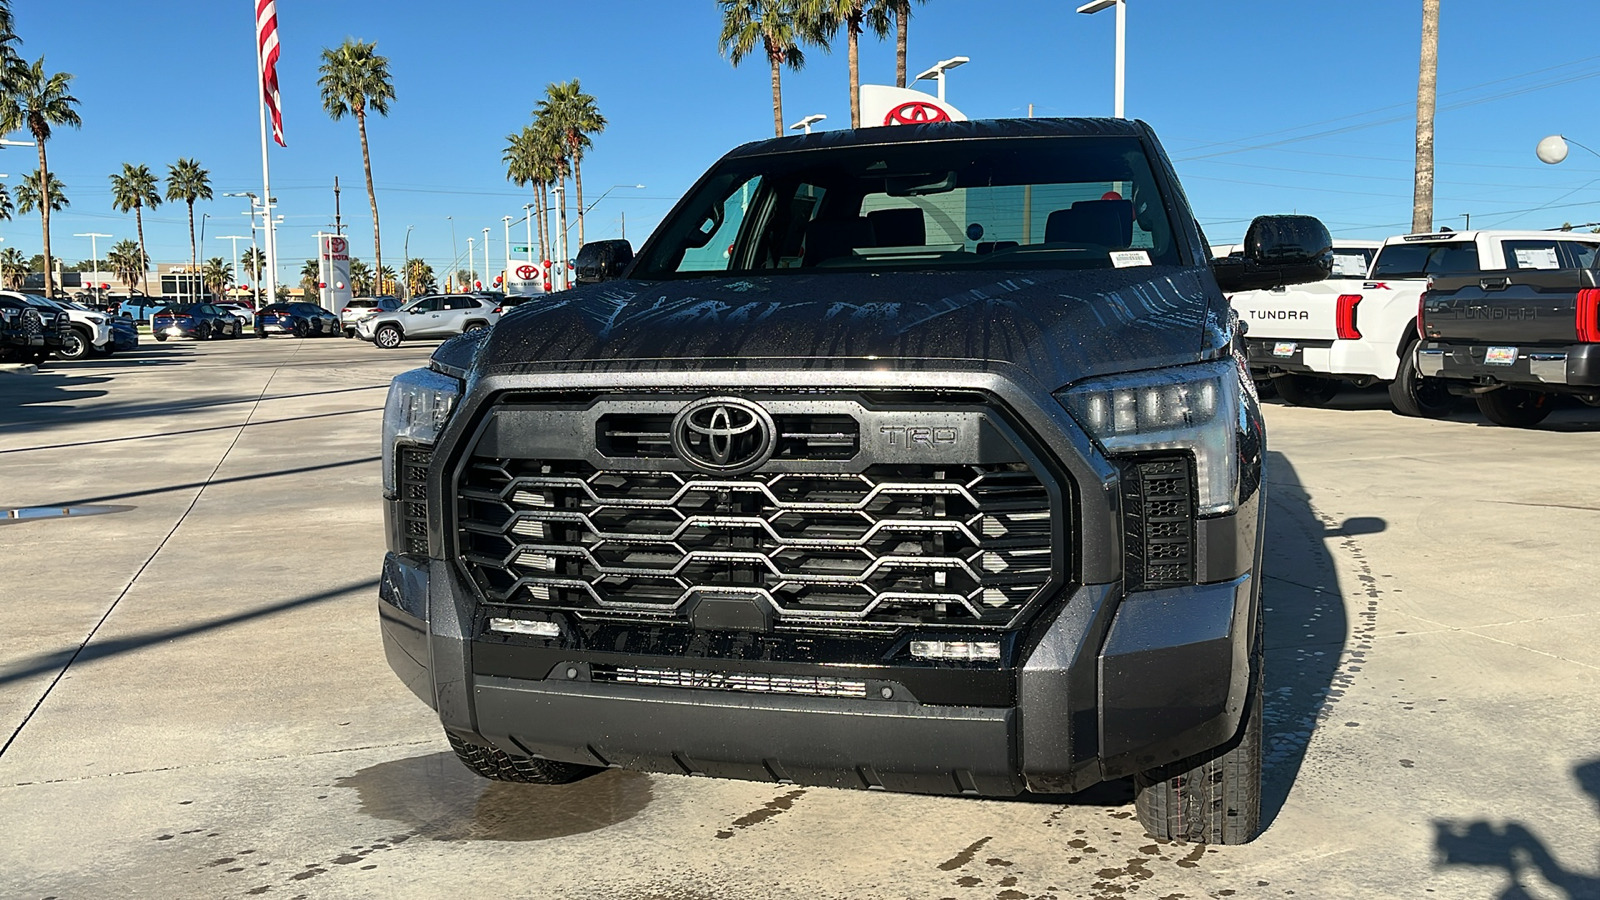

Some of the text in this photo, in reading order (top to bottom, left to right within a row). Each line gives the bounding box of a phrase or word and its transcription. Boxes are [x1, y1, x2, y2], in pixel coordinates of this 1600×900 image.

[1249, 310, 1309, 320] TUNDRA
[1451, 306, 1538, 320] TUNDRA
[880, 426, 959, 449] TRD
